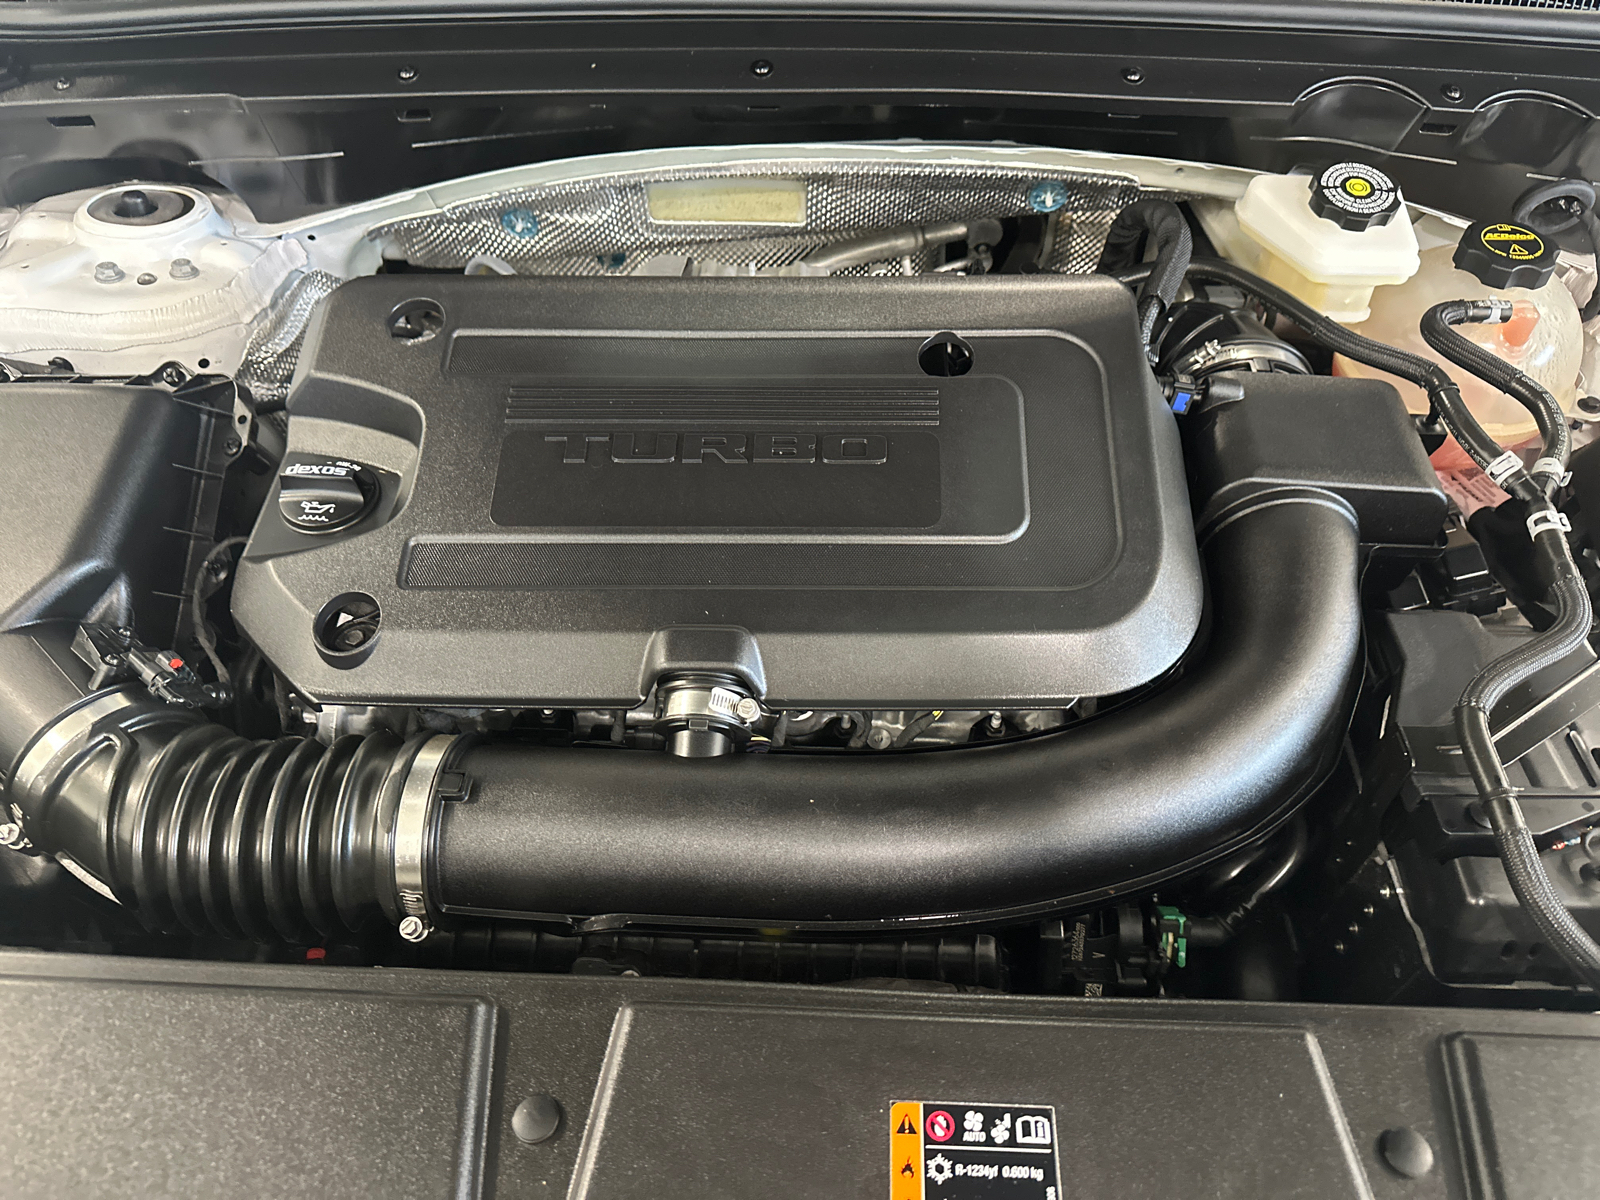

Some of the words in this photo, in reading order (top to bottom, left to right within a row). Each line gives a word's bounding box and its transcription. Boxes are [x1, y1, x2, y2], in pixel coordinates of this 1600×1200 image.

[544, 432, 888, 465] TURBO
[285, 463, 350, 476] dexos
[962, 1131, 987, 1143] AUTO
[1030, 1167, 1044, 1181] kg
